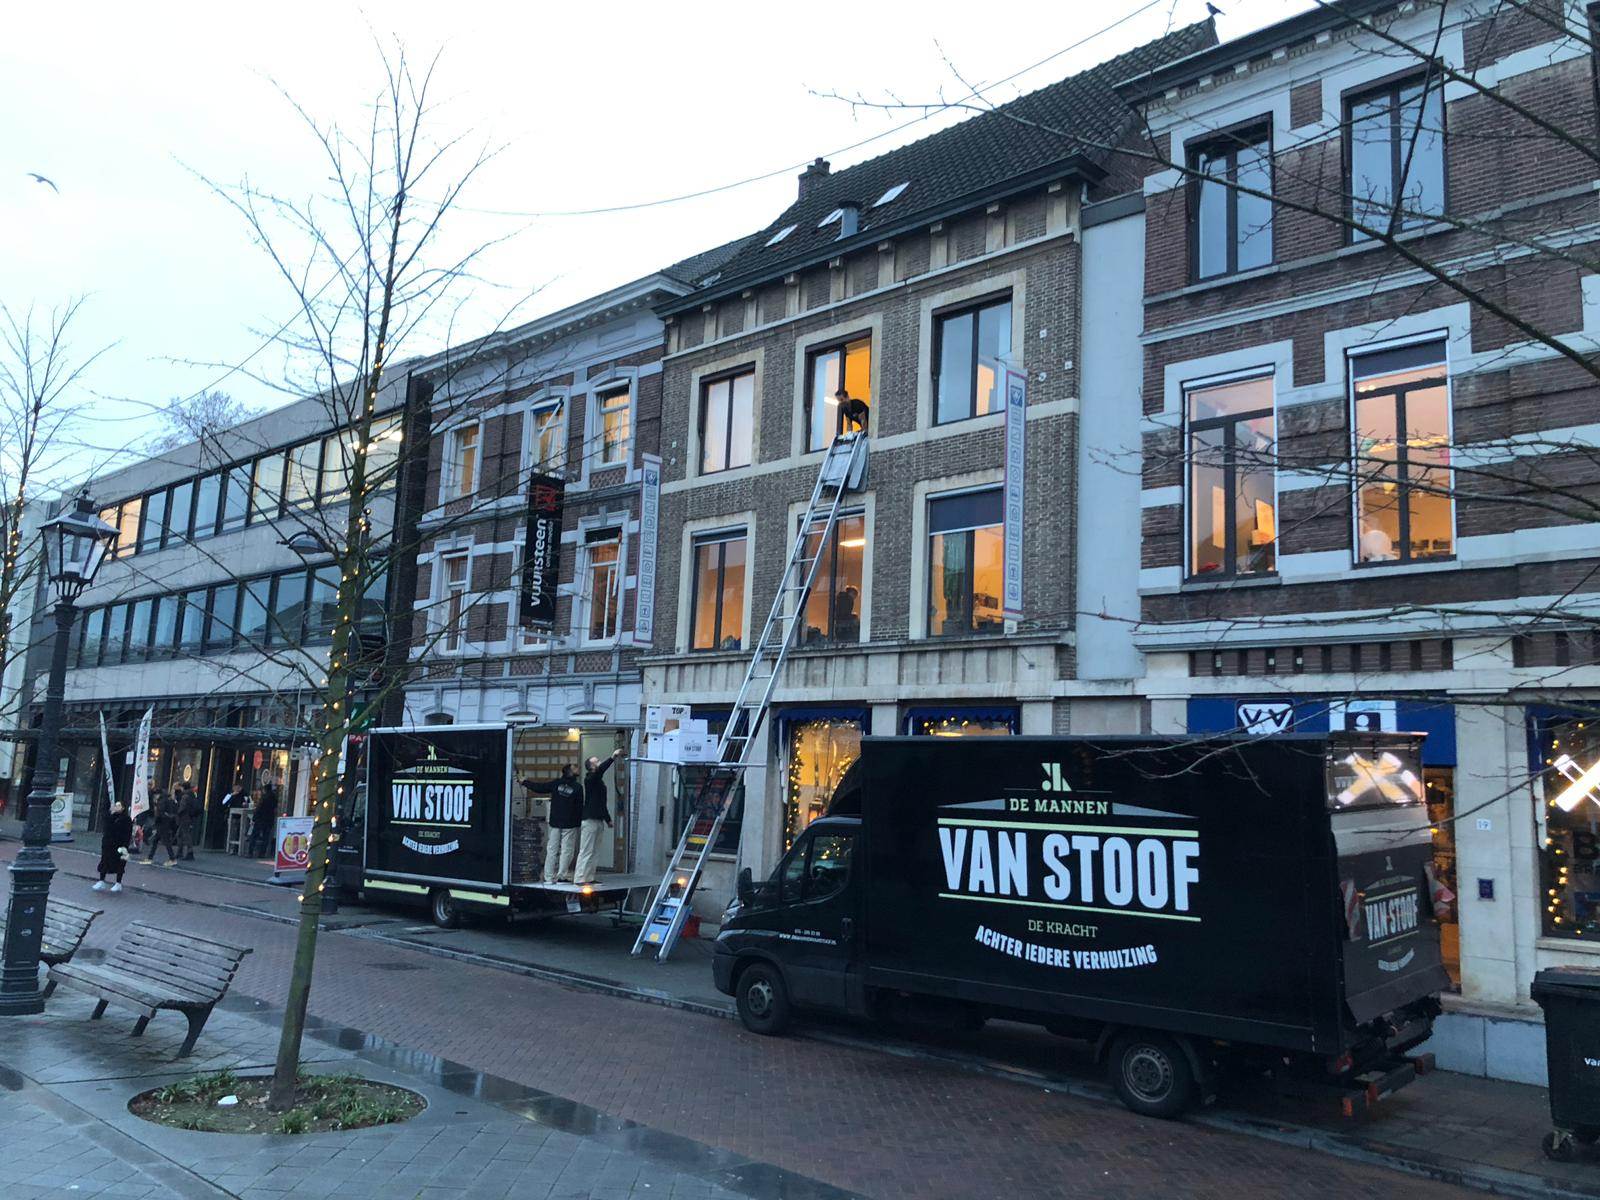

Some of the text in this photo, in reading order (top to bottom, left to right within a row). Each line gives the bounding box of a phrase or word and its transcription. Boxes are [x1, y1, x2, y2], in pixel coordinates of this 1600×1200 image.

[392, 784, 474, 822] VAN STOOF
[1009, 797, 1109, 815] DE MANNEN
[938, 827, 1200, 911] VAN STOOF
[1028, 919, 1099, 938] DE KRACHT
[1365, 893, 1418, 941] VAN STOOF
[974, 925, 1158, 970] ACHTER IEDERE VERHUIZING
